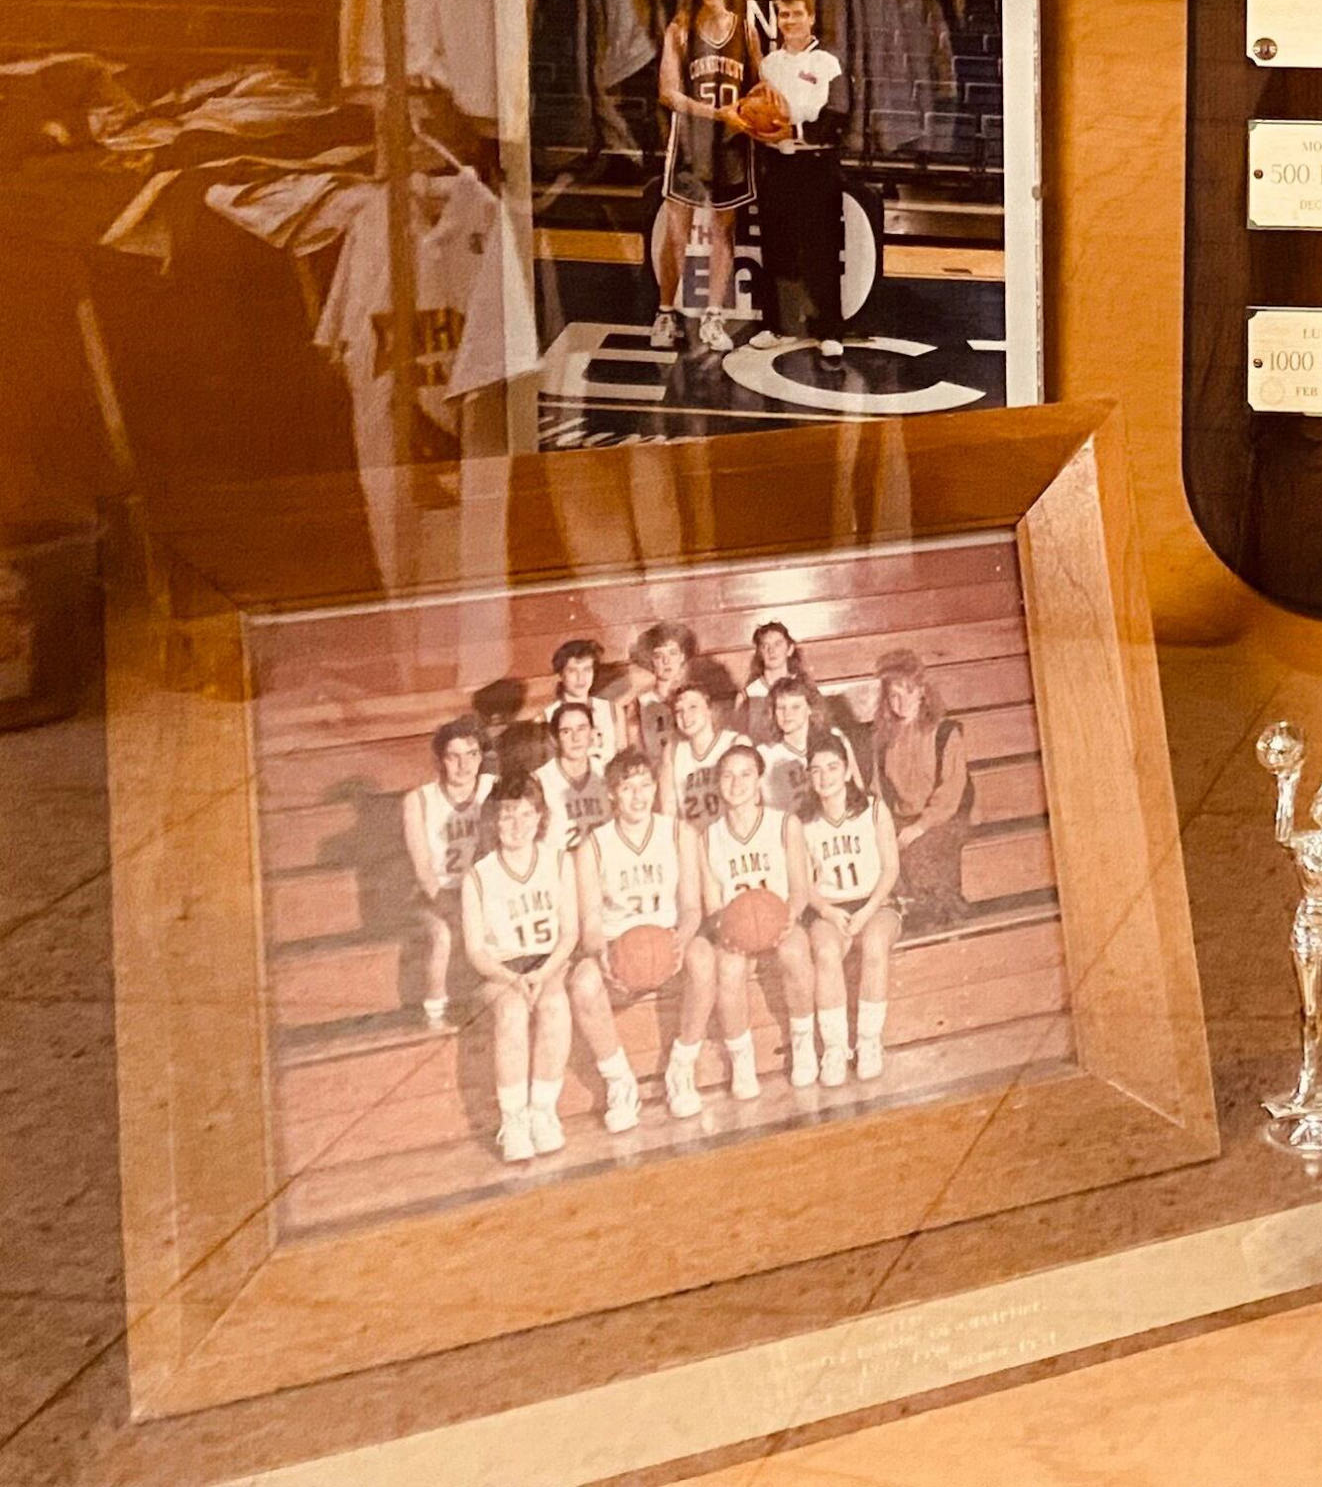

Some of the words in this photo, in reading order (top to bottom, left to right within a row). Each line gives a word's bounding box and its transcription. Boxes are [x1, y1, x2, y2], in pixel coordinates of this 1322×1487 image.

[700, 82, 739, 108] 50
[1270, 163, 1310, 185] 500
[1269, 351, 1314, 372] 1000
[822, 834, 861, 861] RAMS
[729, 852, 771, 879] RAMS
[833, 862, 858, 890] 11
[514, 918, 551, 948] 15
